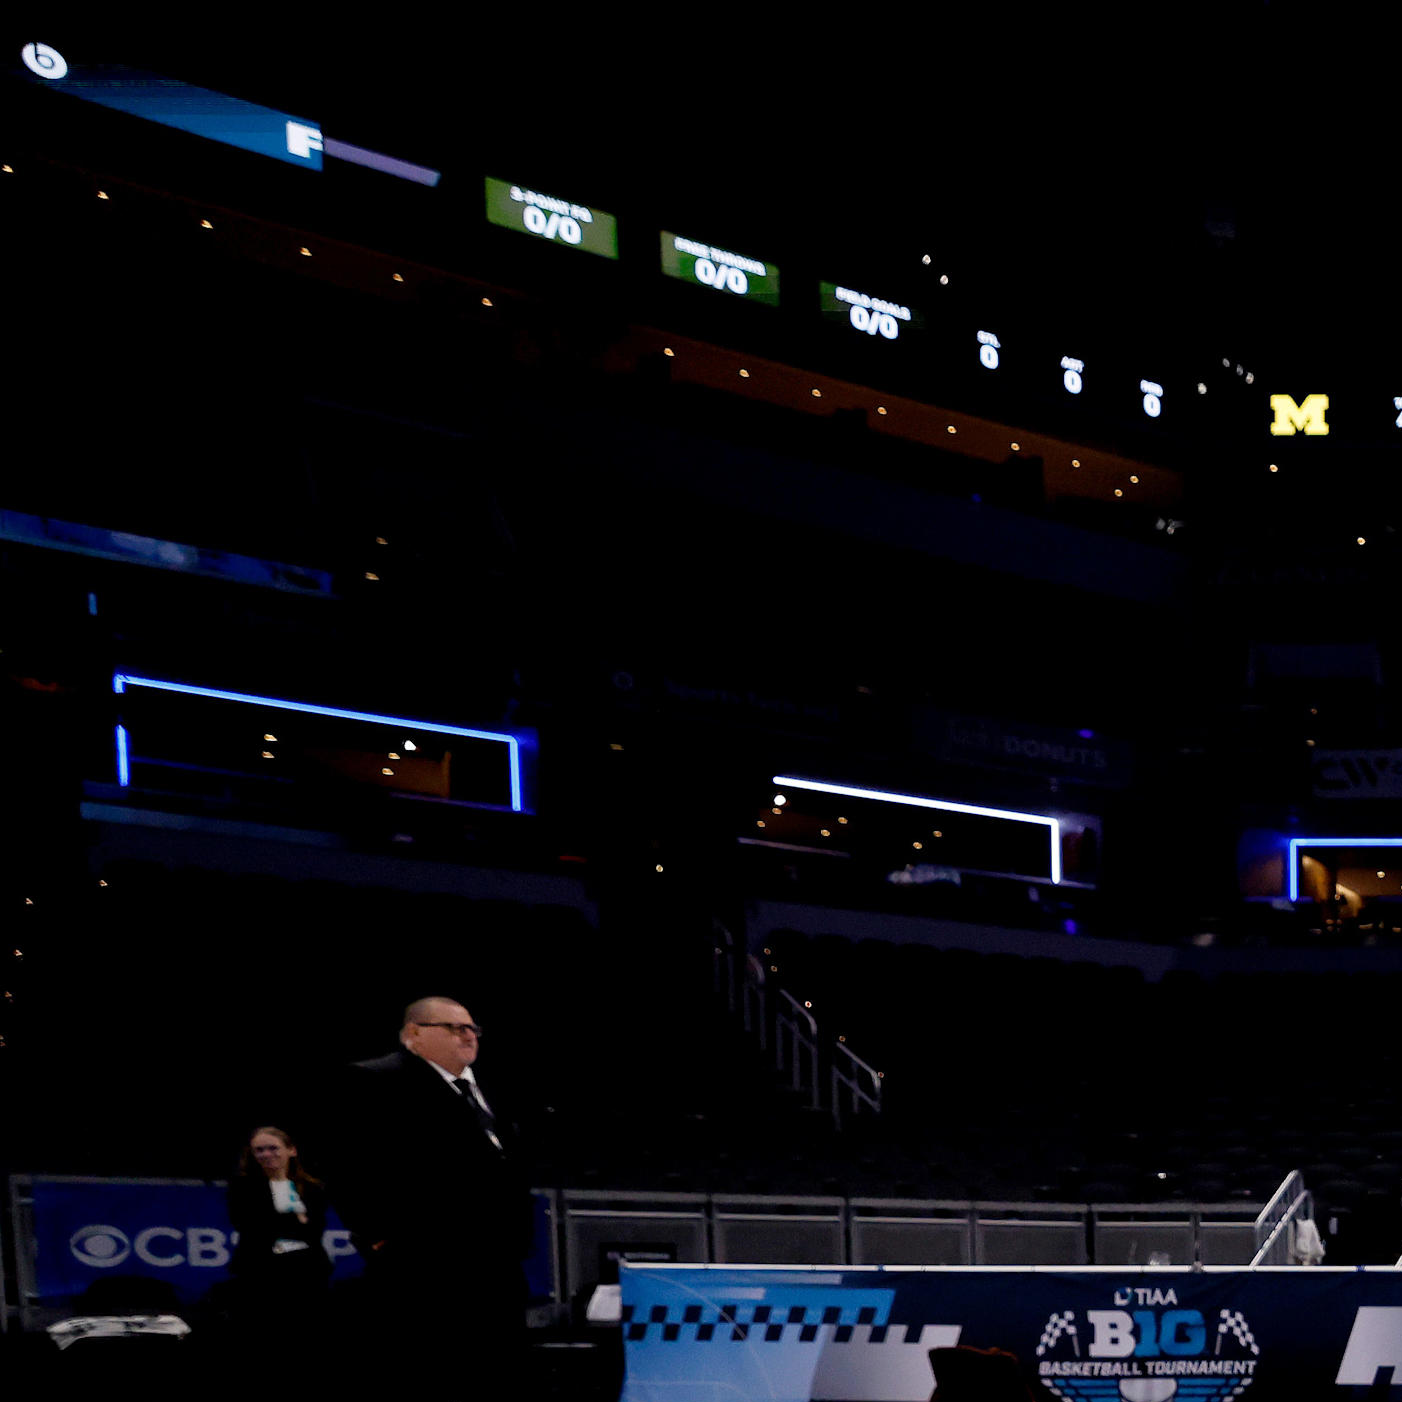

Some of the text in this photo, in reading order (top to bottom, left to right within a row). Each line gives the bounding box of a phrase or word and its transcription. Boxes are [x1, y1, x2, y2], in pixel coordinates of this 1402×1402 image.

[523, 205, 583, 245] 0/0
[694, 257, 748, 294] 0/0
[850, 304, 898, 339] 0/0
[980, 344, 999, 369] 0
[1063, 369, 1082, 394] 0
[1143, 393, 1161, 418] 0
[1269, 394, 1329, 436] M
[133, 1226, 240, 1267] CB
[1135, 1288, 1179, 1306] TIAA
[1038, 1360, 1257, 1377] BASKETBALL TOURNAMENT
